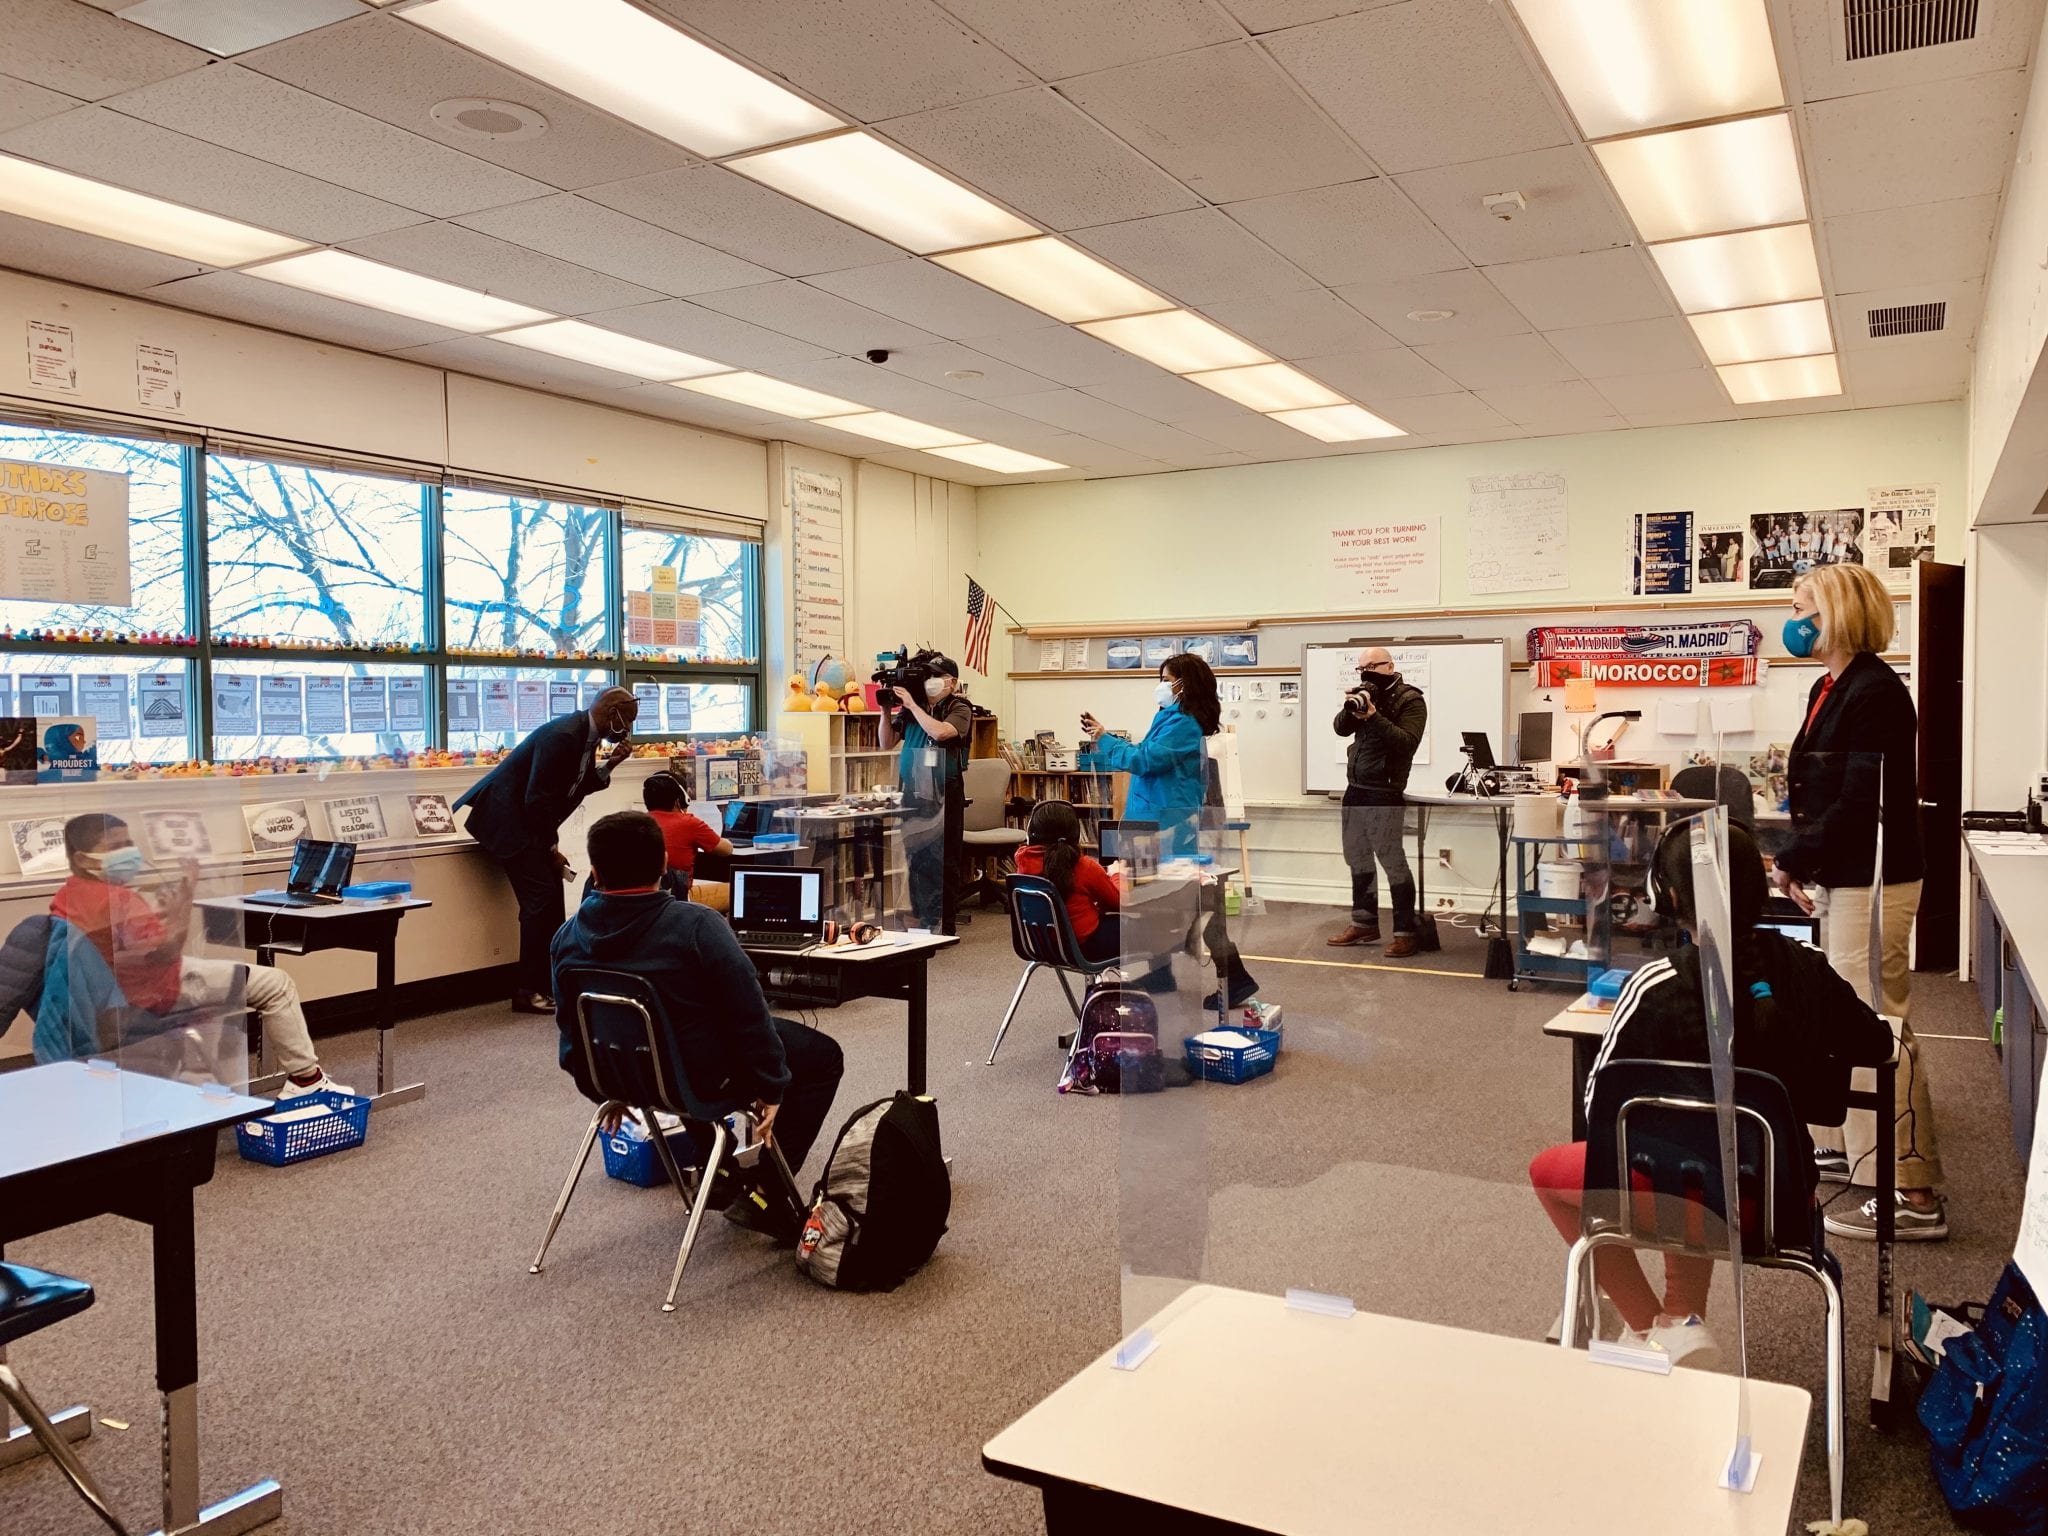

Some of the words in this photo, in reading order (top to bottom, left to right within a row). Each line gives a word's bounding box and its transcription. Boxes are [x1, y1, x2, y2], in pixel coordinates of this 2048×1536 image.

[1907, 508, 1932, 518] 77-71
[1332, 529, 1356, 538] THANK
[1357, 528, 1373, 536] YOU
[1375, 526, 1390, 534] FOR
[1392, 524, 1426, 534] TURNING
[1352, 538, 1371, 547] YOUR
[1374, 537, 1390, 545] BEST
[1392, 536, 1417, 544] WORK!
[1556, 636, 1573, 650] AT.
[1574, 636, 1620, 650] MADRID
[1591, 664, 1698, 681] MOROCCO
[52, 760, 93, 768] PROUDEST
[338, 808, 370, 818] LISTEN
[422, 804, 438, 812] WORK
[264, 815, 294, 826] WORD
[350, 816, 362, 826] TO
[422, 815, 446, 824] WRITING
[266, 822, 295, 834] WORK
[340, 822, 375, 833] READING
